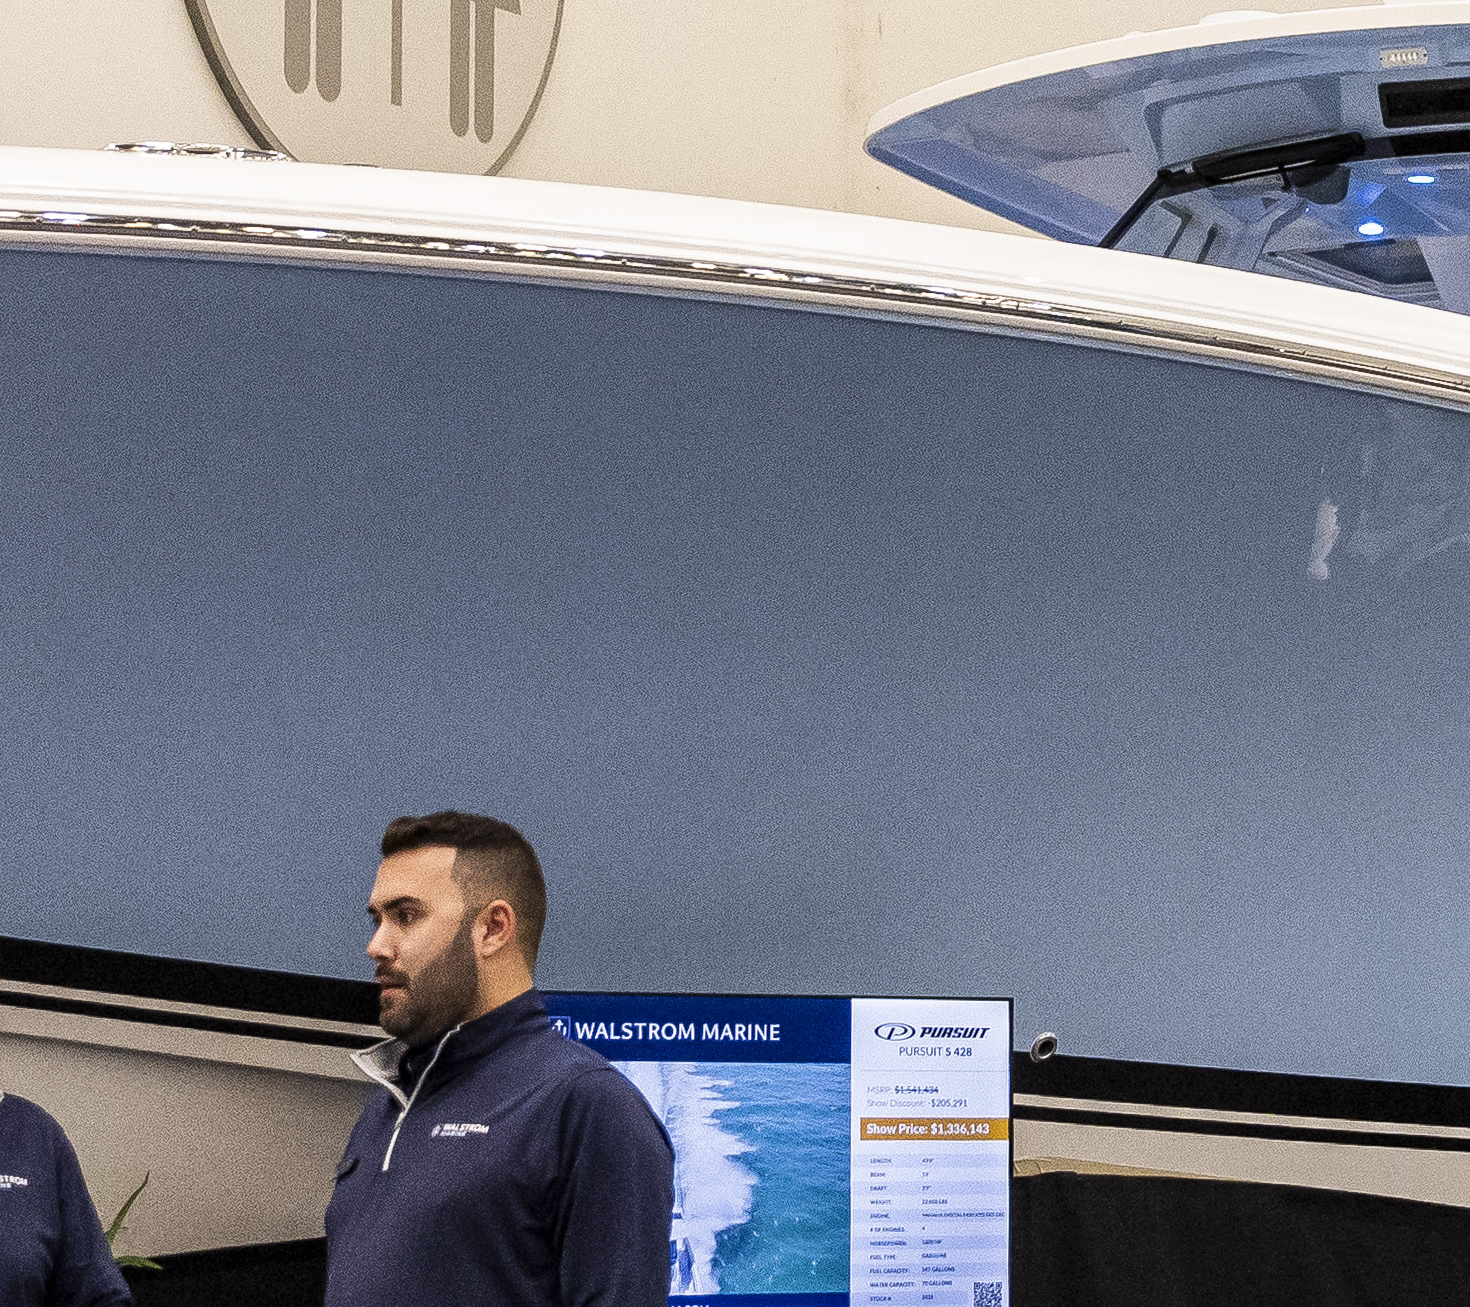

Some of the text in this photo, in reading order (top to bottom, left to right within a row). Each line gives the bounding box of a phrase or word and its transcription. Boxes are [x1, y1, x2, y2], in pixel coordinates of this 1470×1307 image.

[575, 1021, 781, 1041] WALSTROM MARINE
[919, 1026, 991, 1039] PURSUIT
[899, 1046, 943, 1057] PURSUIT
[953, 1046, 973, 1057] 428
[866, 1122, 990, 1135] Show Price: $1,336,143
